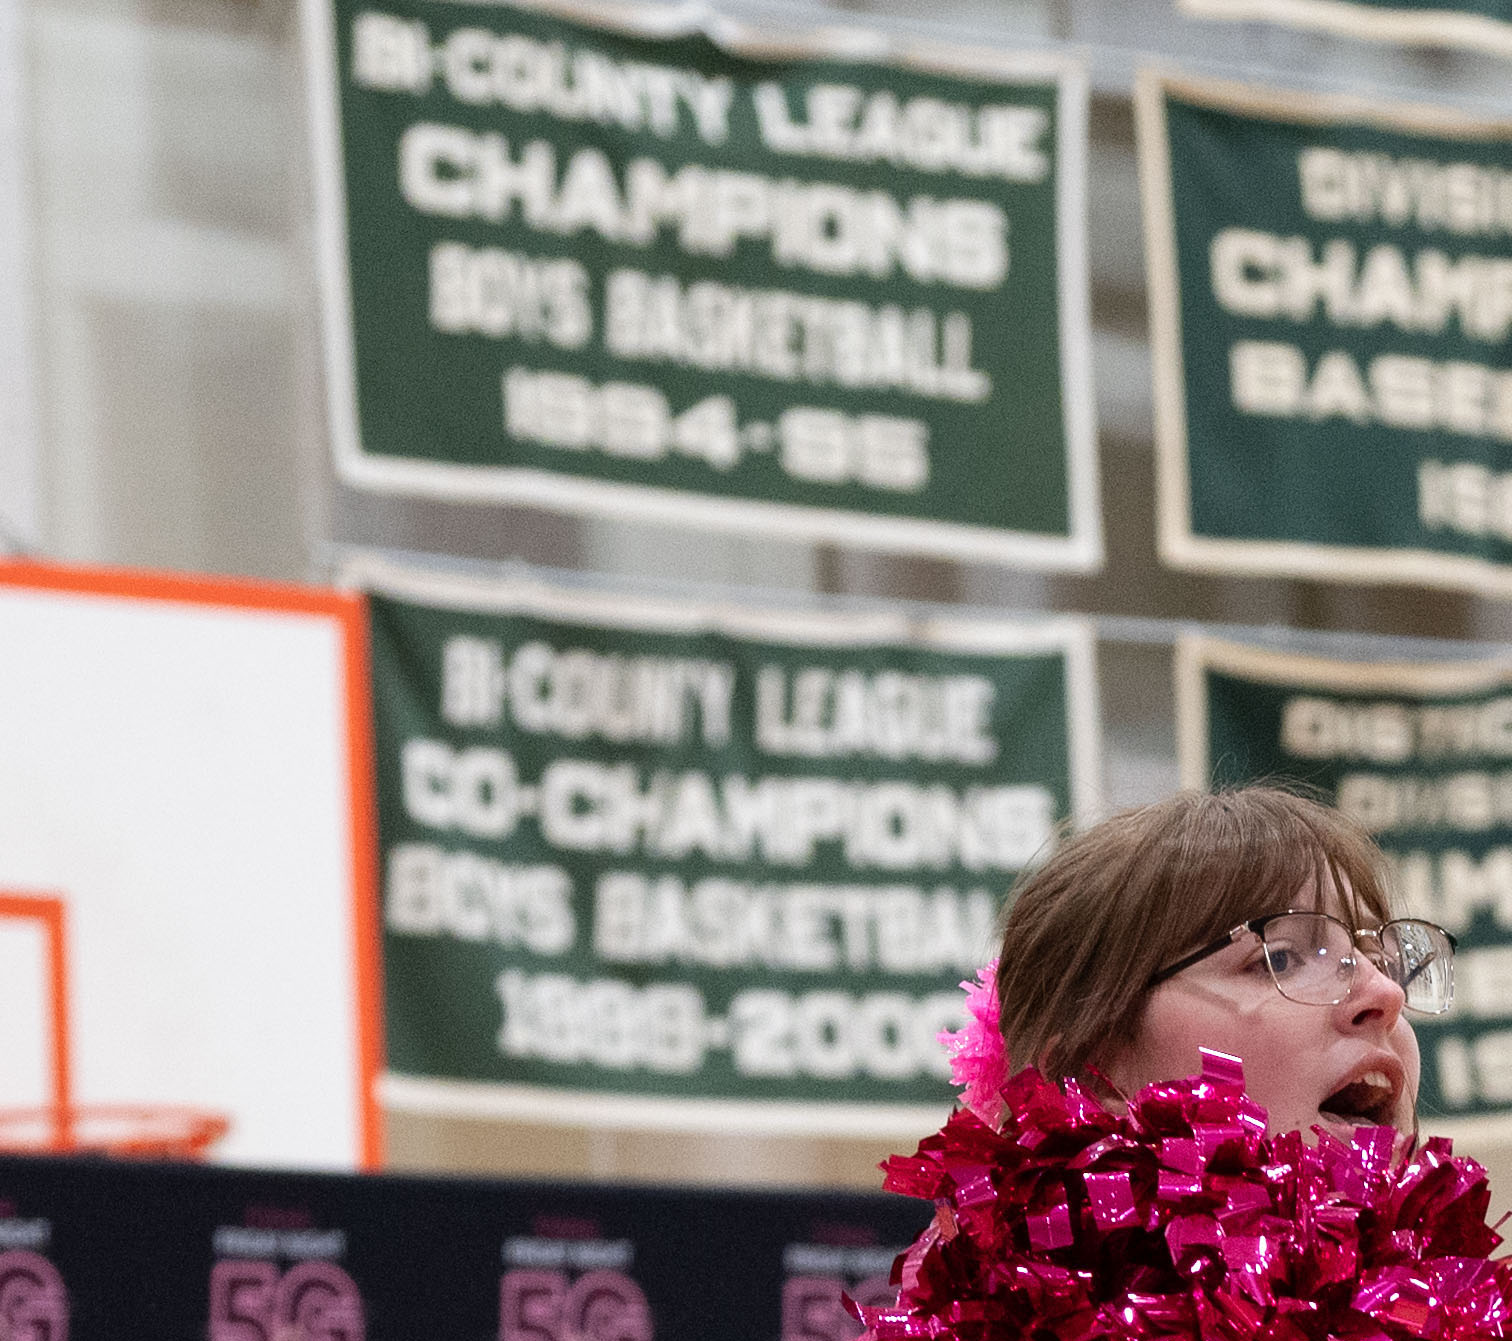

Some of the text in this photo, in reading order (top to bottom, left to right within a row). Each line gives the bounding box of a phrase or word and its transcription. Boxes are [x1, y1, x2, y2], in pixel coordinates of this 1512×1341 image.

[752, 83, 1051, 179] LEAGUE
[400, 121, 1009, 288] CHAMPIONS
[429, 243, 993, 401] BOYS BASKETBALL
[755, 667, 997, 764] LEAGUE
[400, 740, 1055, 872] CO-CHAMPIONS
[388, 843, 573, 955] BOYS
